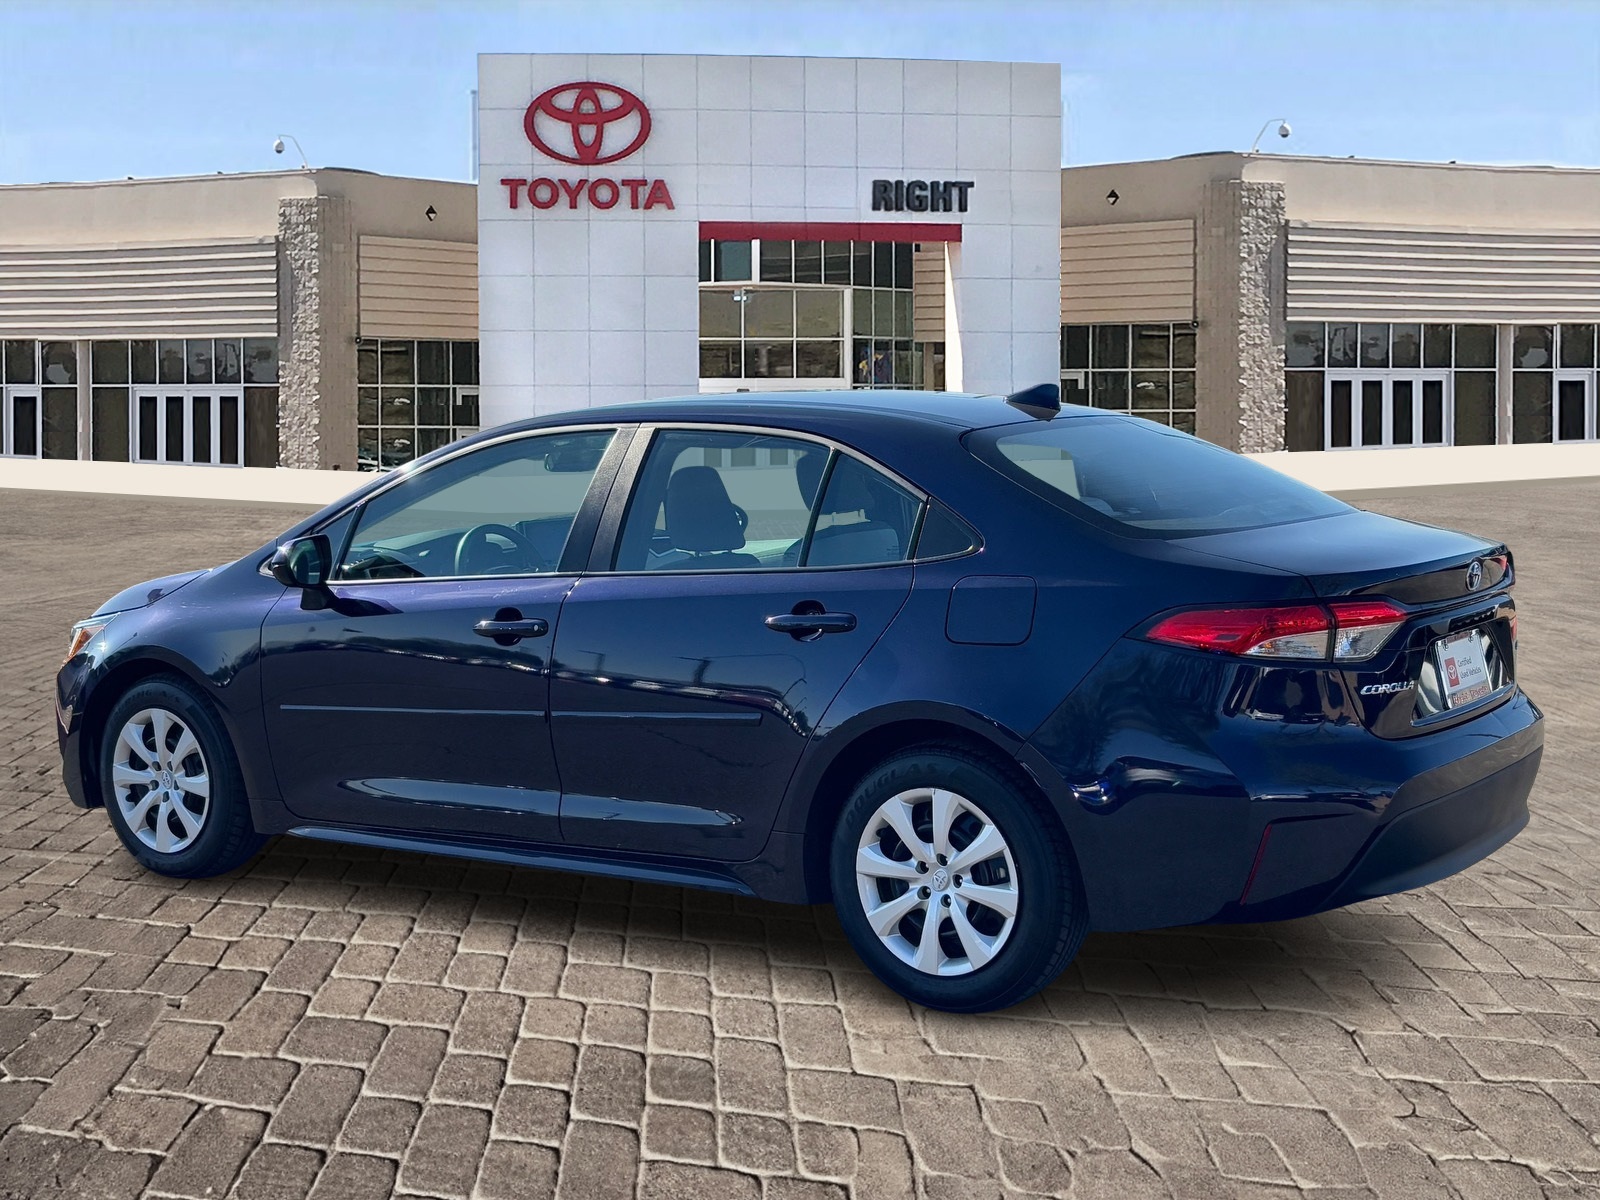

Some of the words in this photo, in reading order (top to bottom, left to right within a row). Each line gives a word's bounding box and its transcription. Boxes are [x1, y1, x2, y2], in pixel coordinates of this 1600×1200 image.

[500, 178, 675, 210] TOYOTA
[871, 179, 975, 212] RIGHT
[1457, 656, 1472, 668] Certified
[1360, 680, 1415, 696] COROLLA
